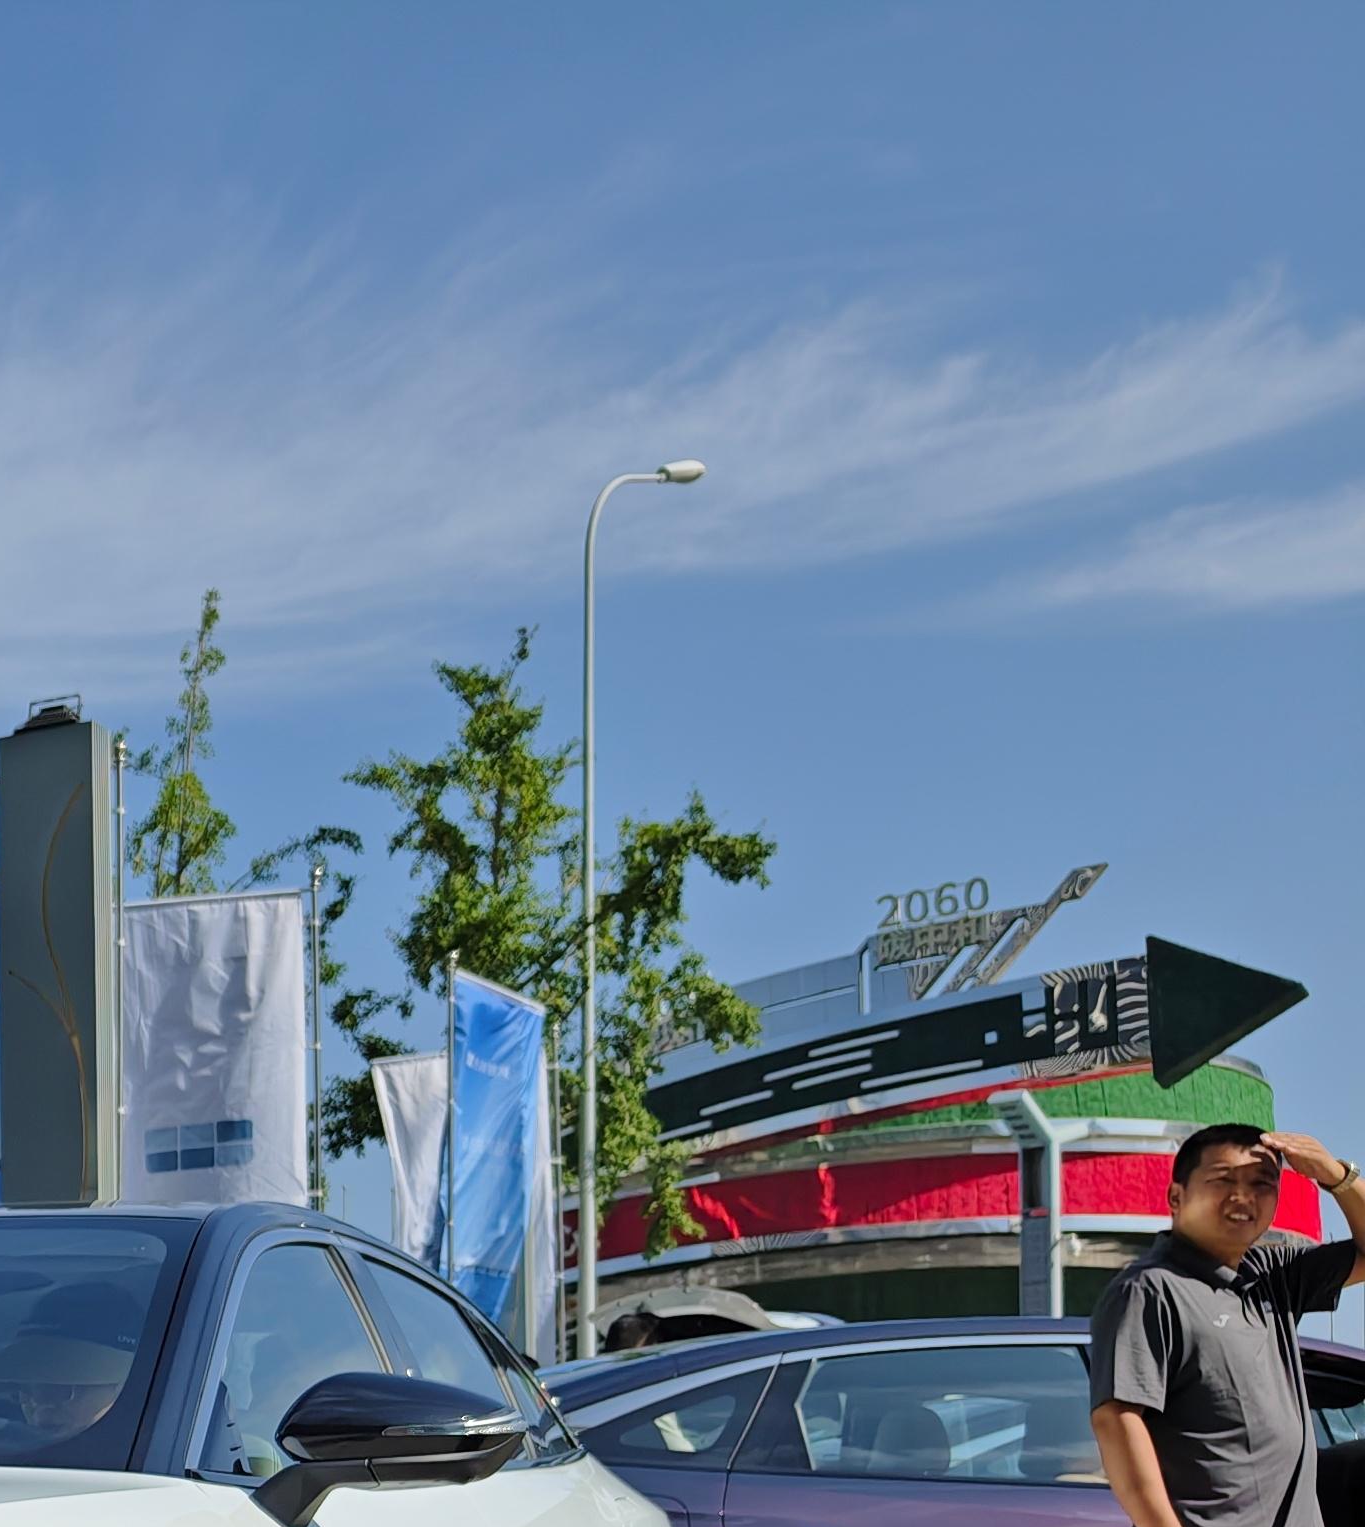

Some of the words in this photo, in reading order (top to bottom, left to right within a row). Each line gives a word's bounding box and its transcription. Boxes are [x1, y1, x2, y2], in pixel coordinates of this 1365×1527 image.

[876, 877, 989, 929] 2060
[878, 914, 990, 965] 碳中和
